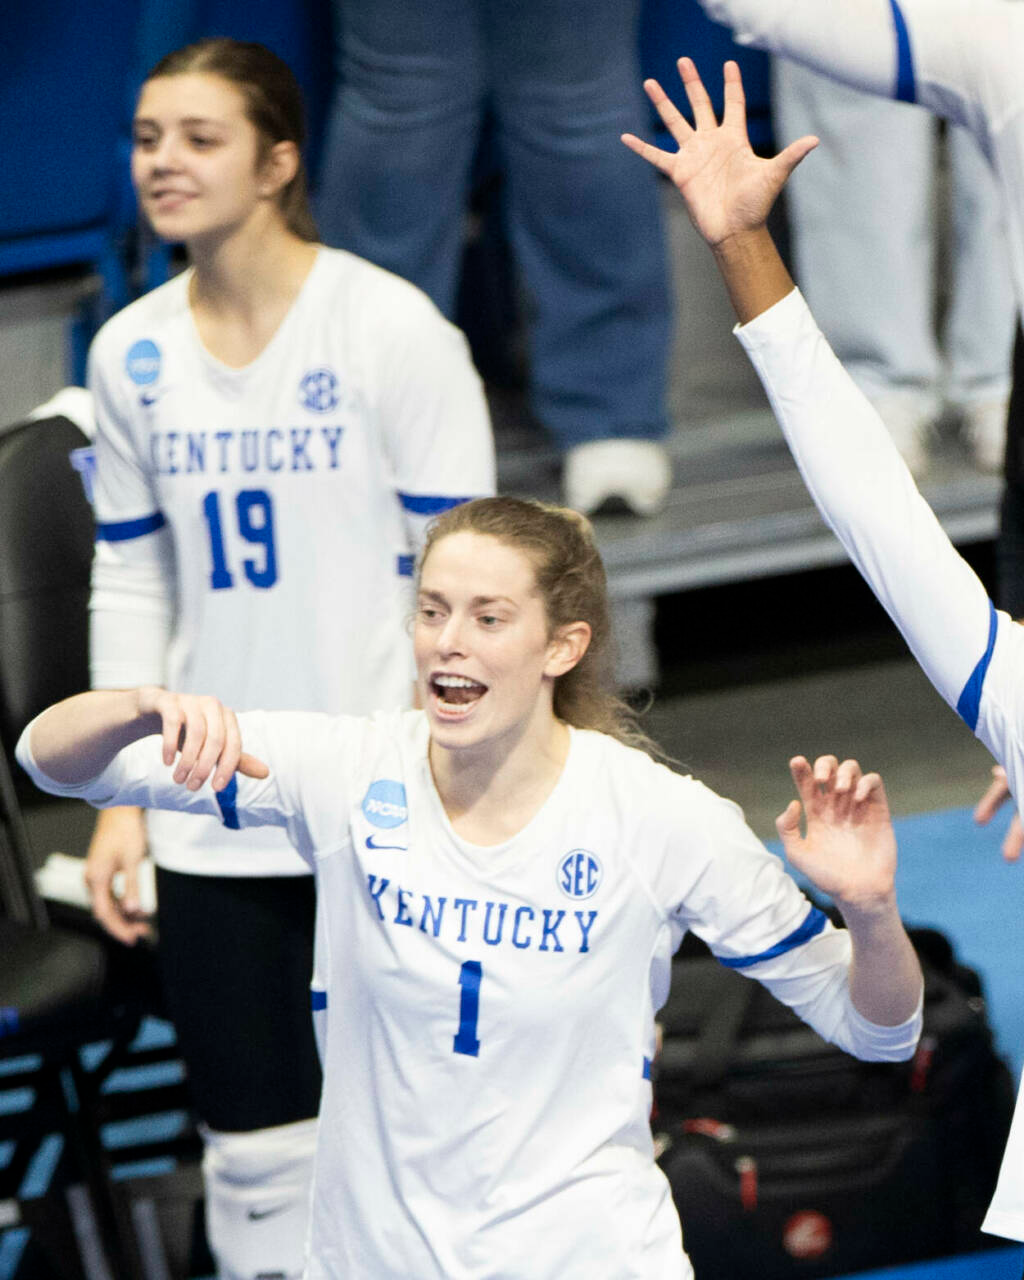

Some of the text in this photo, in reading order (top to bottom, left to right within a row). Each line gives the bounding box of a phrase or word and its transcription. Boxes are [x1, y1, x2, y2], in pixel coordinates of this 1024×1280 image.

[202, 487, 280, 591] 19
[366, 873, 599, 954] KENTUCKY
[561, 852, 600, 896] SEC
[452, 959, 486, 1058] 1
